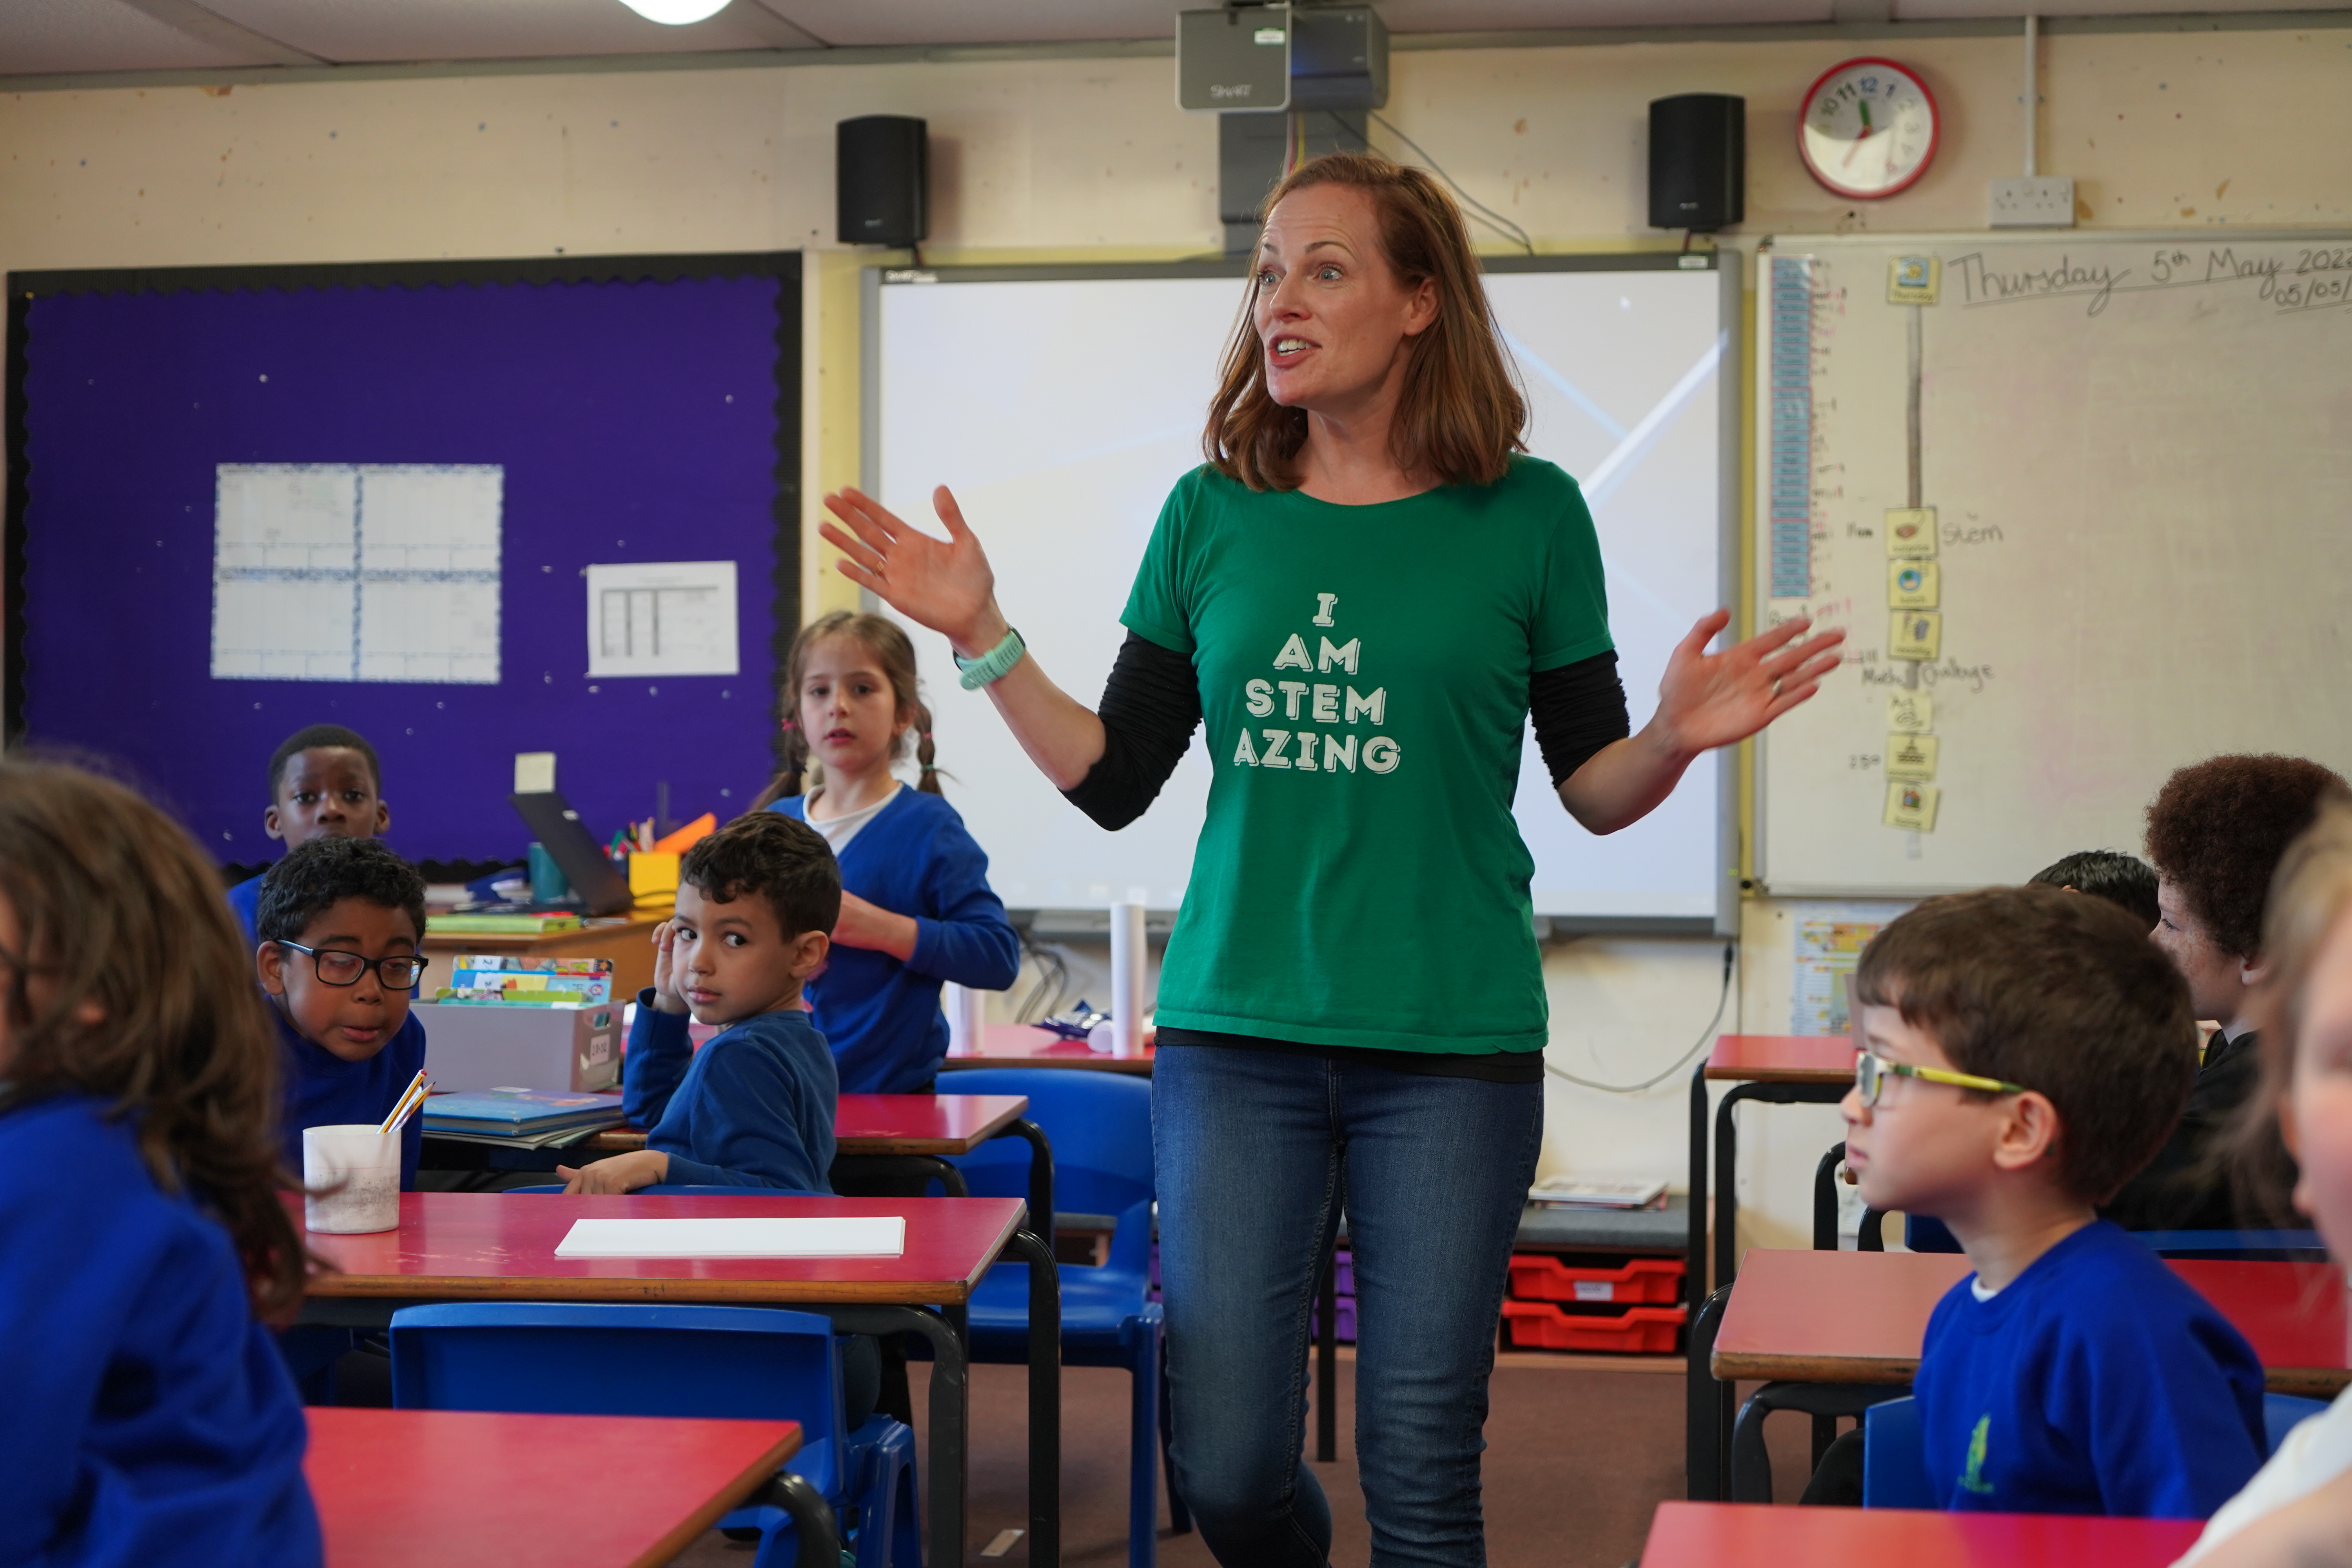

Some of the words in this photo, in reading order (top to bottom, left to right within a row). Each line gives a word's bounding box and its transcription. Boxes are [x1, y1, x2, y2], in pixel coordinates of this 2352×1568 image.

[1210, 84, 1253, 99] SMART
[1835, 82, 1857, 101] 11
[1859, 76, 1879, 93] 12
[1886, 83, 1896, 98] 1
[1821, 97, 1839, 116] 10
[1947, 251, 2131, 317] Thursday
[2151, 250, 2191, 283] 5th
[2206, 247, 2284, 301] May
[1312, 592, 1338, 627] I
[1272, 633, 1361, 675] AM
[1245, 679, 1387, 726] STEM
[1233, 727, 1401, 775] AZING
